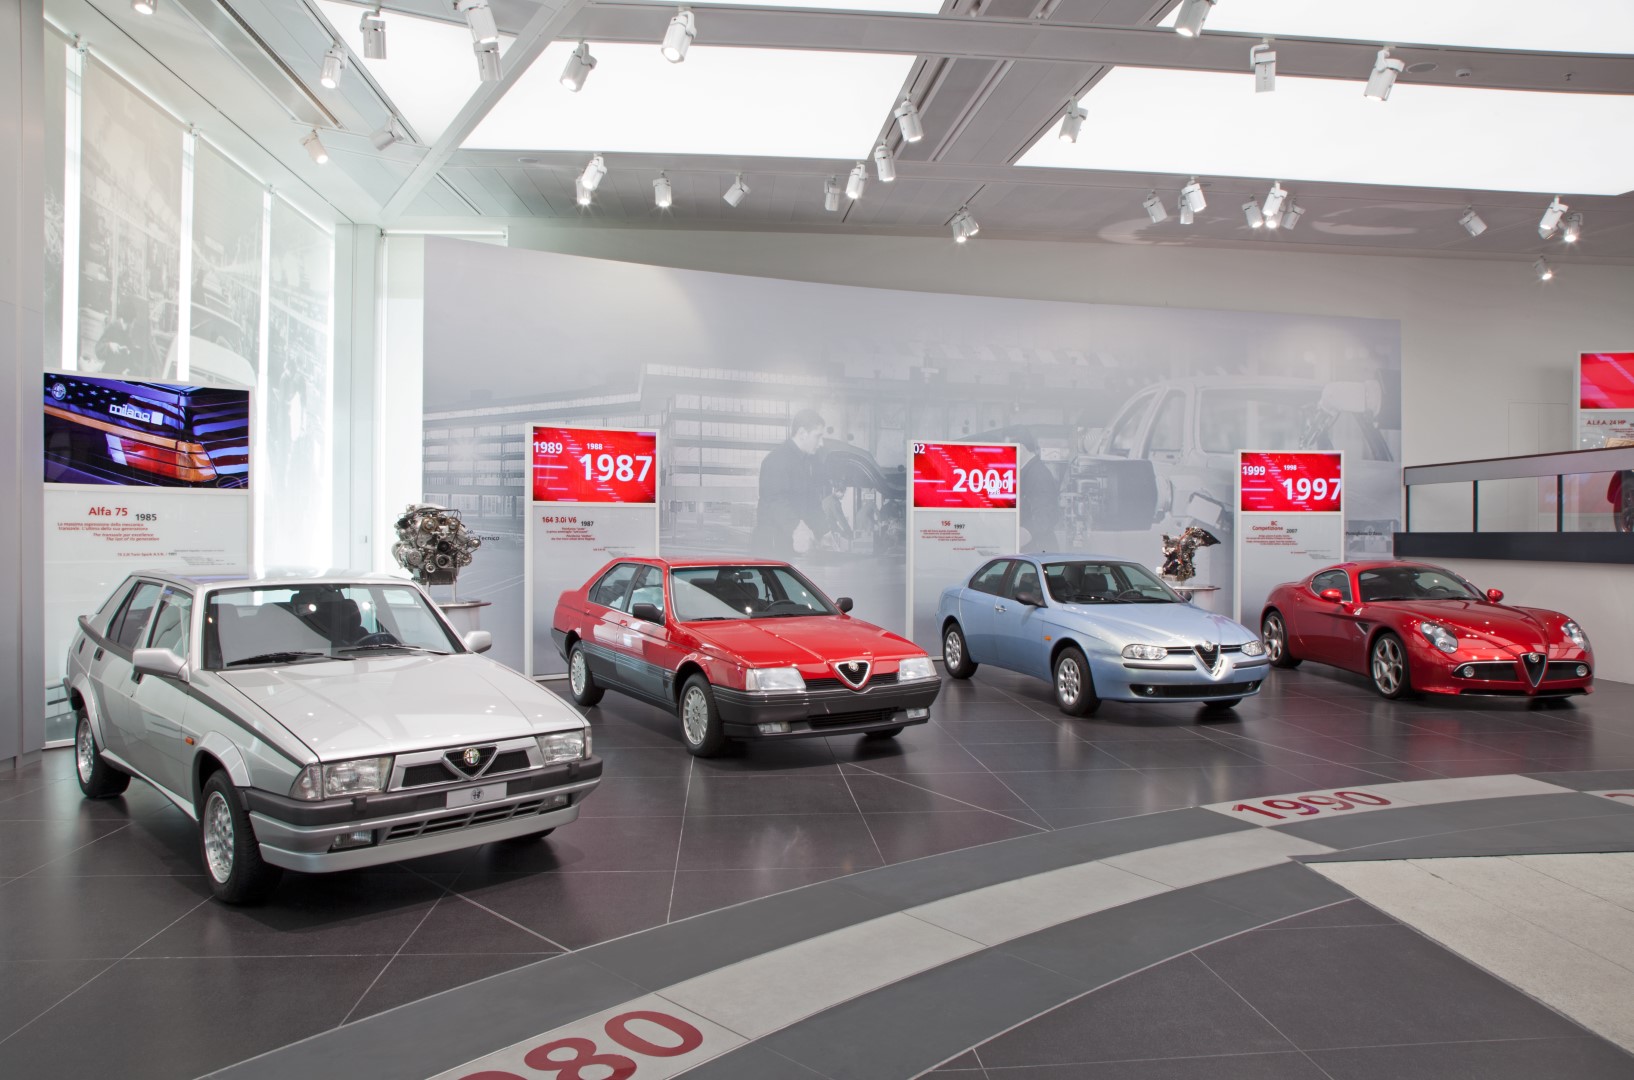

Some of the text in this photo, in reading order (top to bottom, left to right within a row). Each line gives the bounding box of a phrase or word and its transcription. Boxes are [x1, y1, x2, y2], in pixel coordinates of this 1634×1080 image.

[109, 404, 151, 423] milano
[533, 441, 563, 454] 1989
[579, 453, 653, 482] 1987
[1242, 466, 1266, 476] 1999
[952, 468, 1014, 493] 2001
[1281, 477, 1341, 501] 1997
[88, 506, 157, 521] Alfa 75 1985
[1232, 791, 1392, 820] 1990
[457, 1010, 704, 1080] 80
